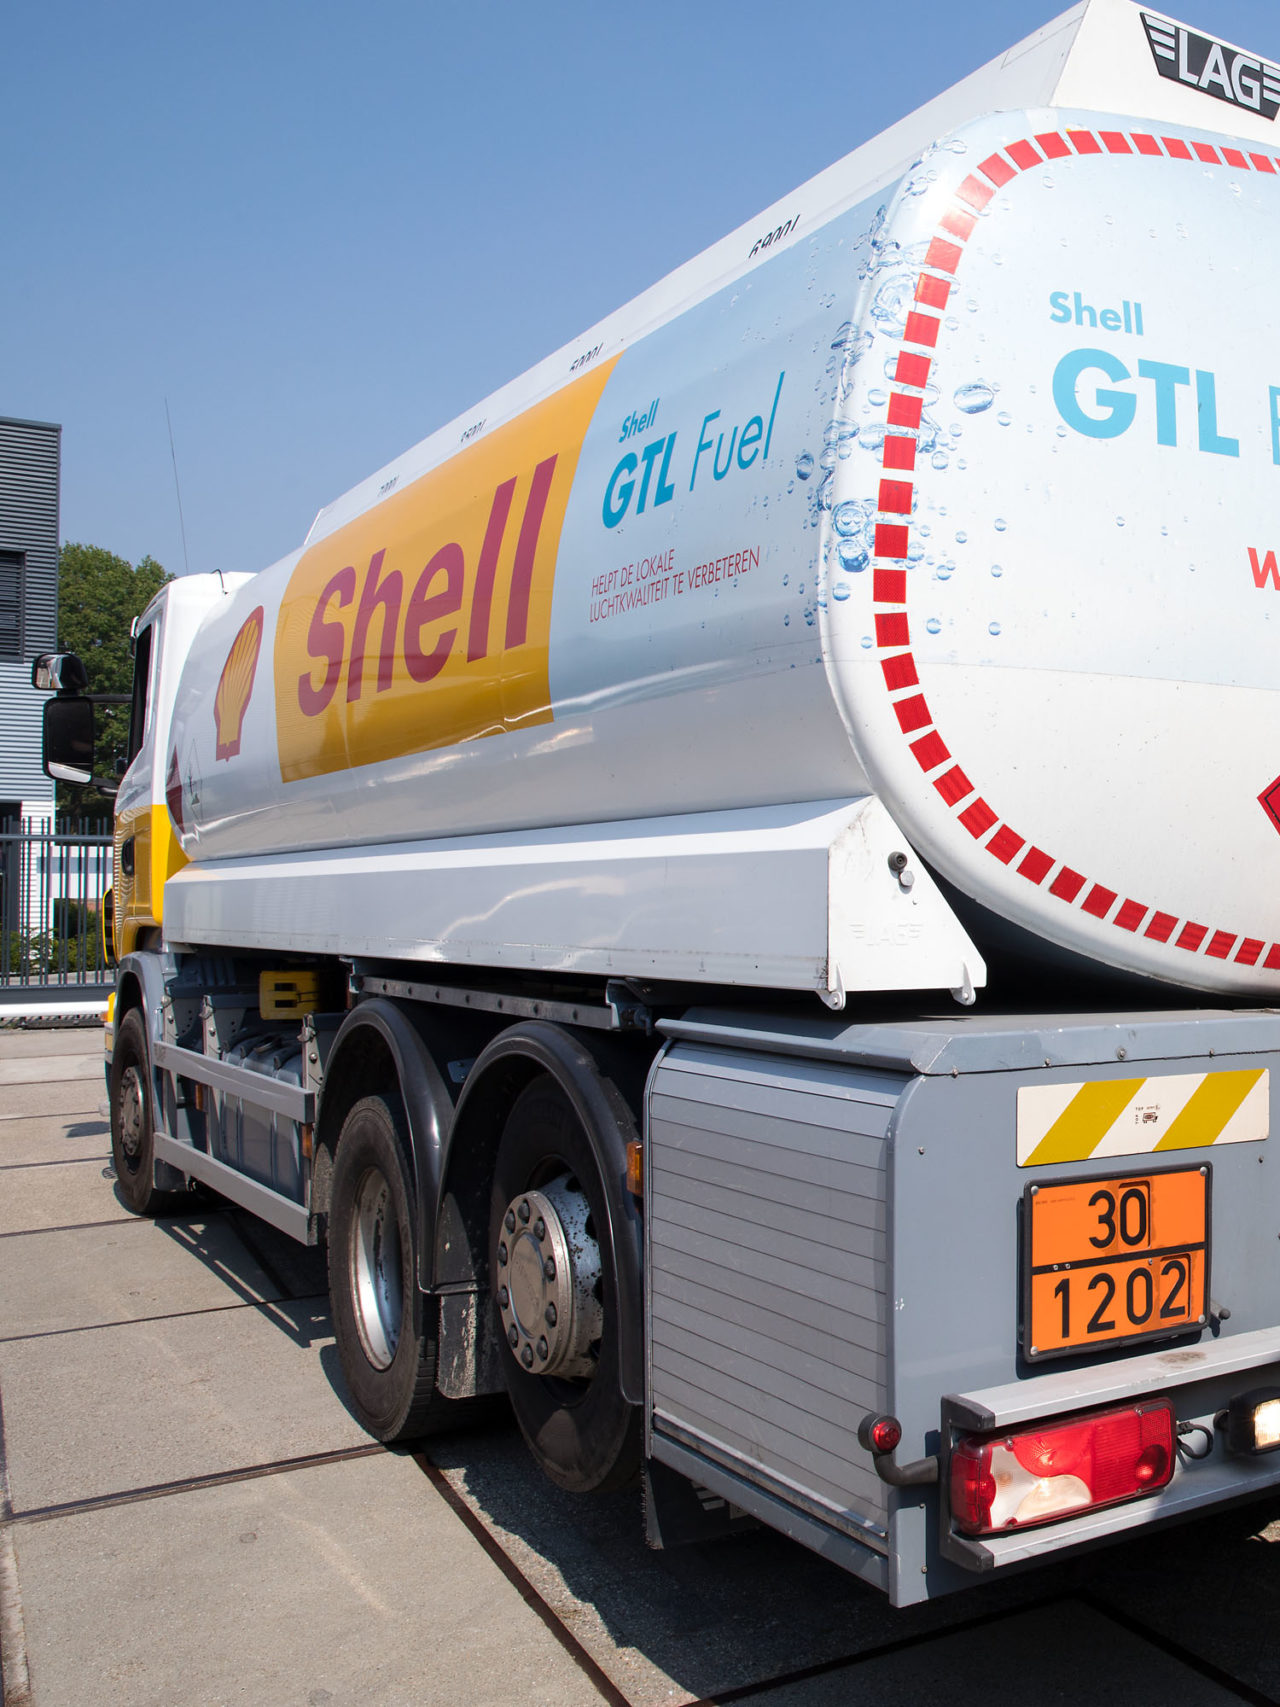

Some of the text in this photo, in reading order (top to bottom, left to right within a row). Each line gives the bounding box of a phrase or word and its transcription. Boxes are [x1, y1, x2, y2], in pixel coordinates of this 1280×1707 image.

[1178, 28, 1261, 111] LAG
[1049, 291, 1144, 336] Shell
[618, 397, 660, 443] Shell
[1052, 348, 1240, 458] GTL
[602, 370, 786, 529] GTL Fuel
[298, 453, 559, 717] Shell
[589, 545, 760, 623] LUCHTKWALITEIT TE VERBETEREN
[591, 548, 675, 598] HELPT DE LOKALE
[1087, 1188, 1148, 1249] 30
[1053, 1259, 1186, 1339] 1202
